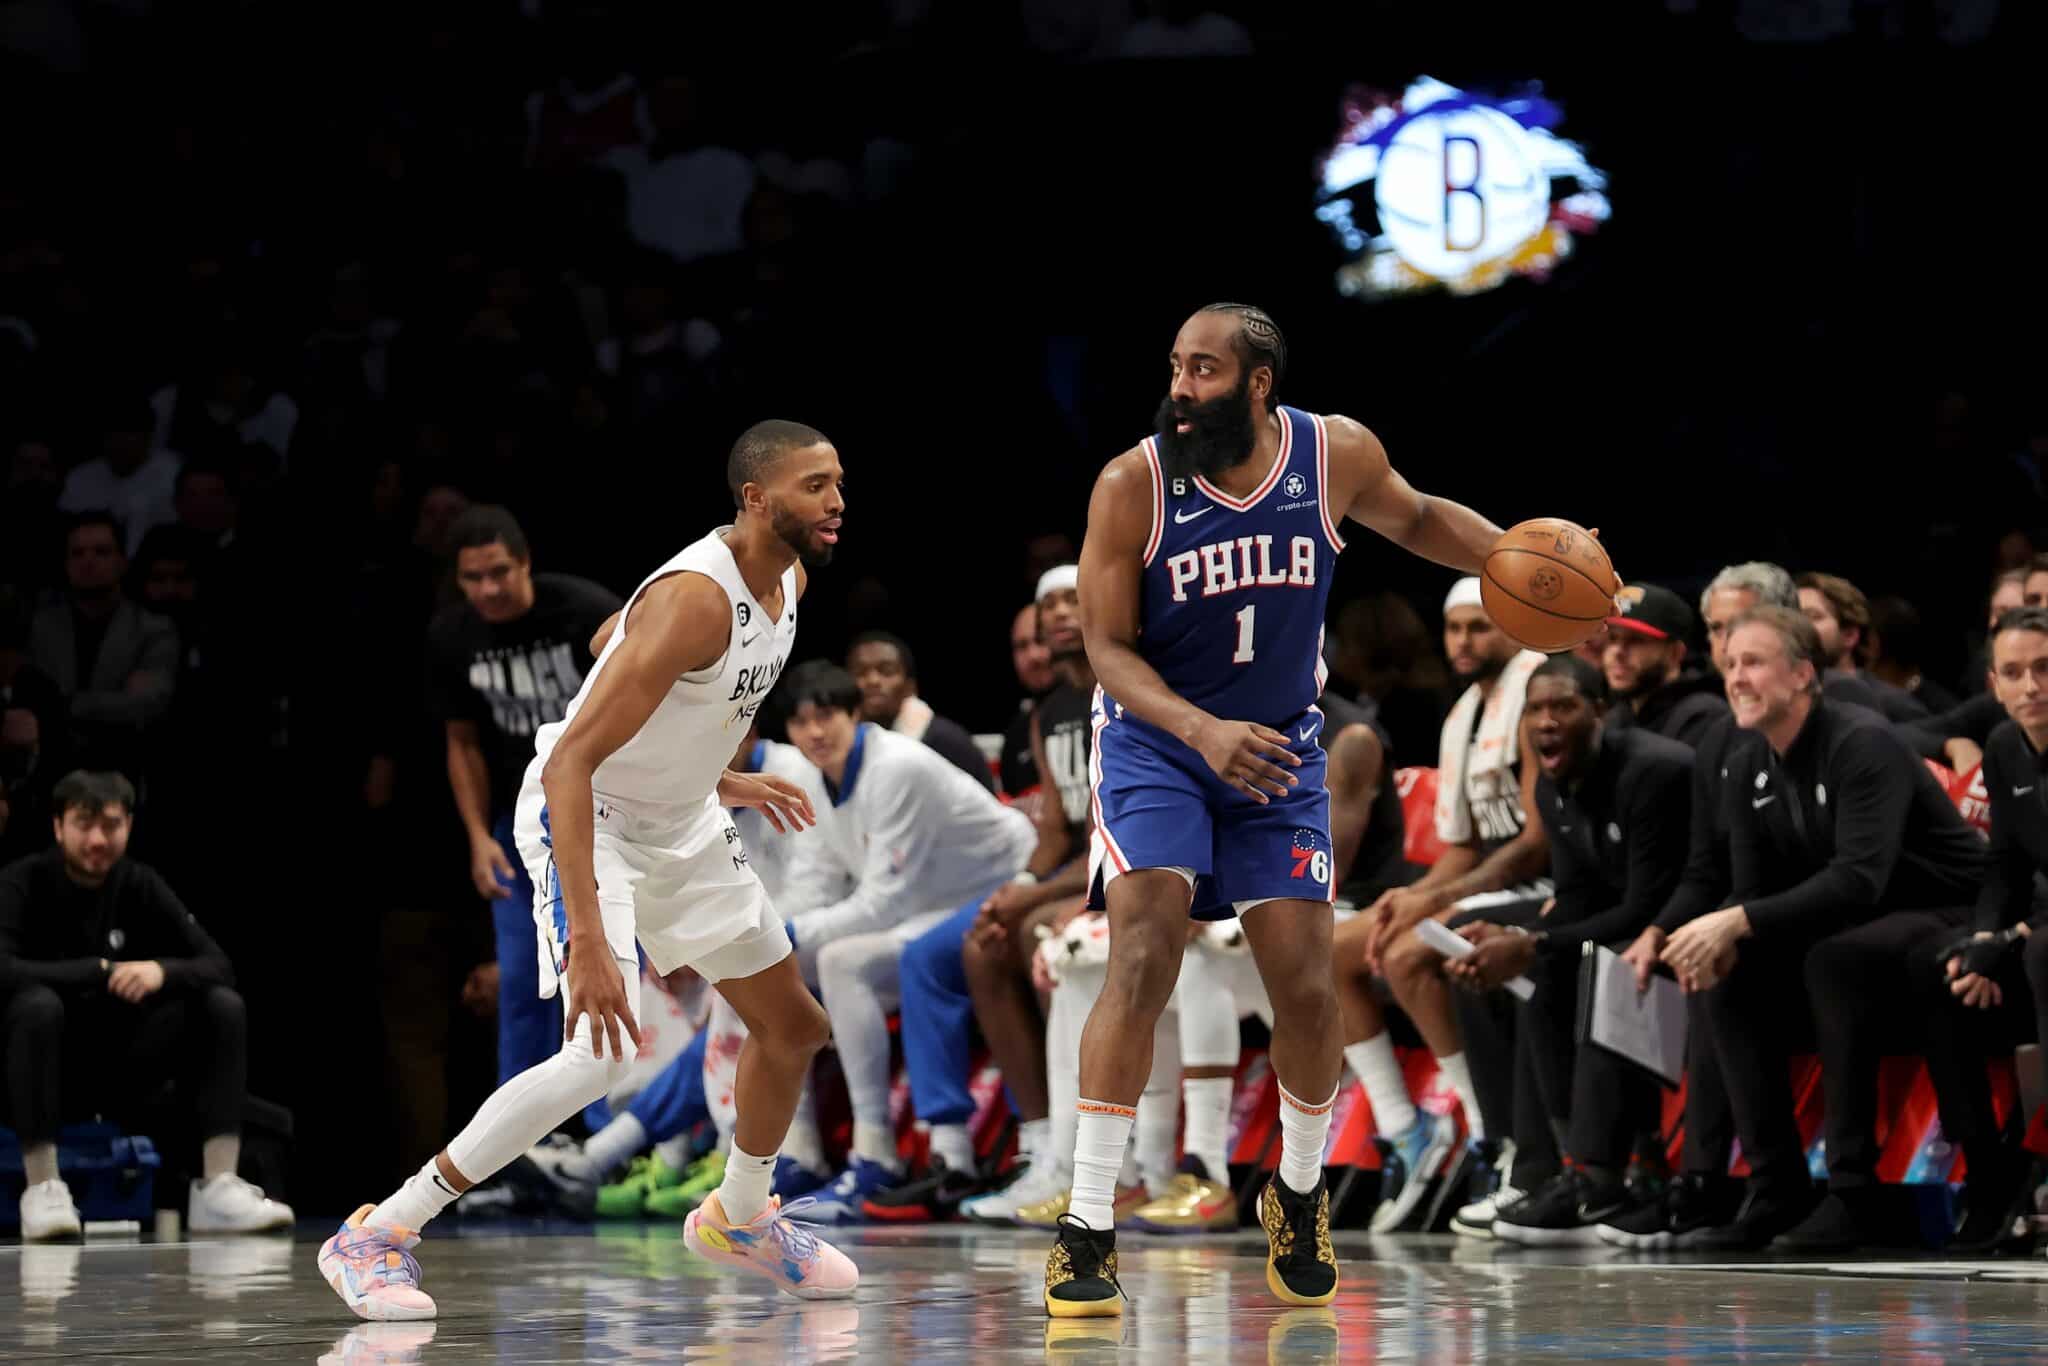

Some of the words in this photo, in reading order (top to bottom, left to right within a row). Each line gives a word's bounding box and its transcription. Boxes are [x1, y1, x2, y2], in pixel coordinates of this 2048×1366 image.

[1444, 136, 1486, 251] B
[1171, 478, 1187, 497] 6
[1275, 499, 1318, 512] crypto.com
[1165, 534, 1317, 603] PHILA
[738, 603, 749, 626] 6
[1232, 603, 1257, 665] 1
[1289, 845, 1329, 884] 76
